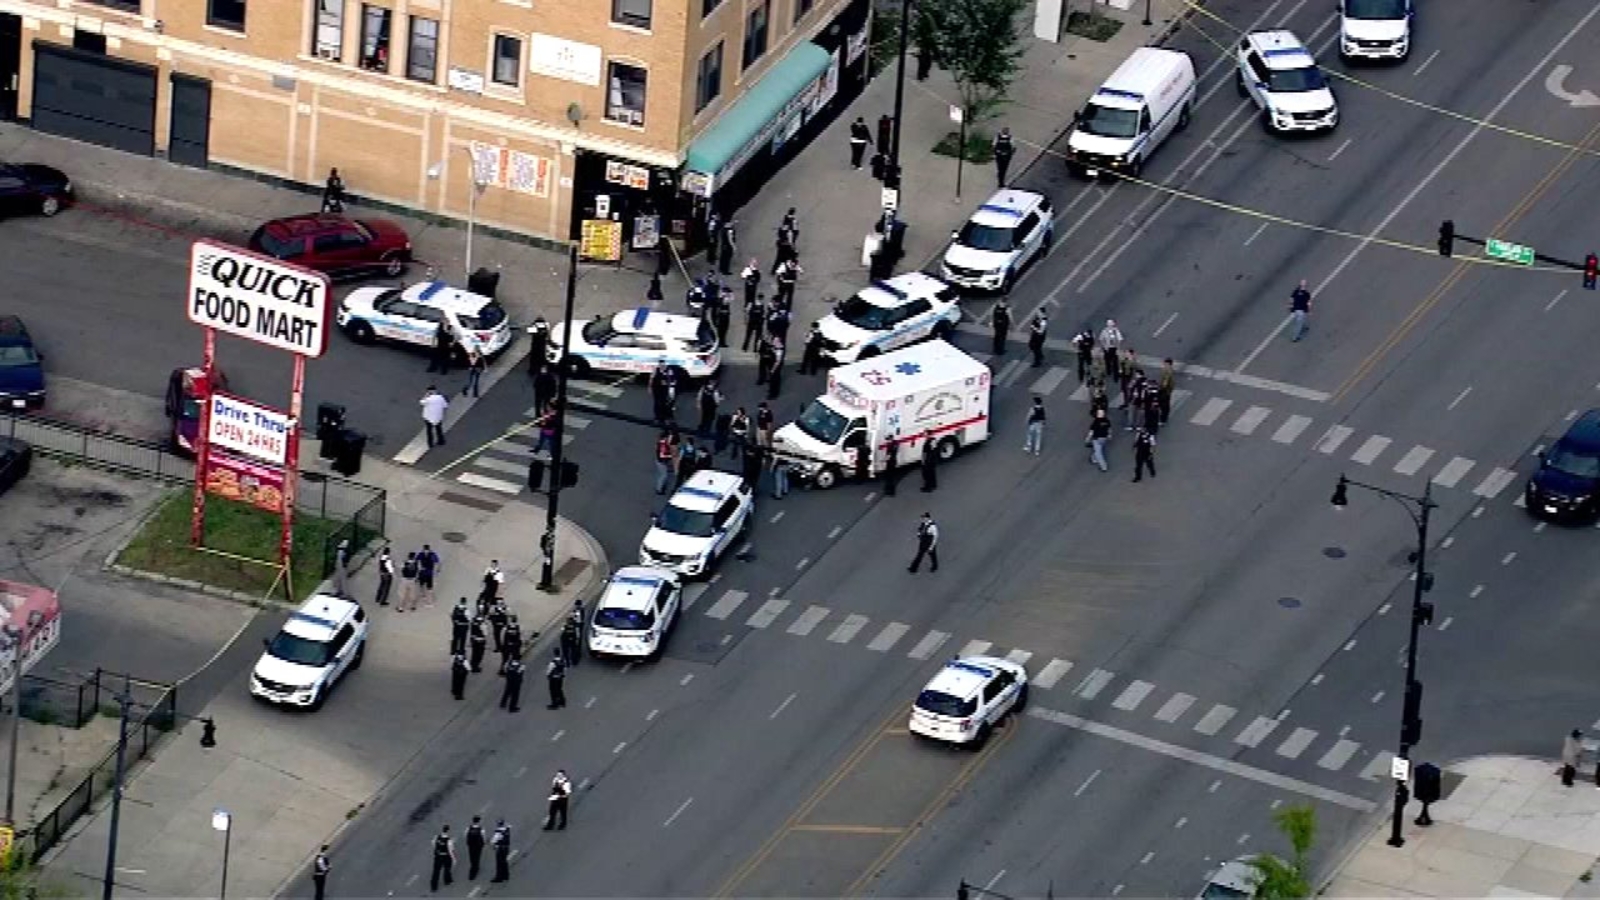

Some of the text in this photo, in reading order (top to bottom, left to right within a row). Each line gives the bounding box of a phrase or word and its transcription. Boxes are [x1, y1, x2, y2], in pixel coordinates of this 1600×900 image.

[211, 257, 320, 308] QUICK
[194, 287, 318, 348] FOOD MART
[214, 400, 285, 433] Drive Thru
[215, 420, 244, 443] OPEN
